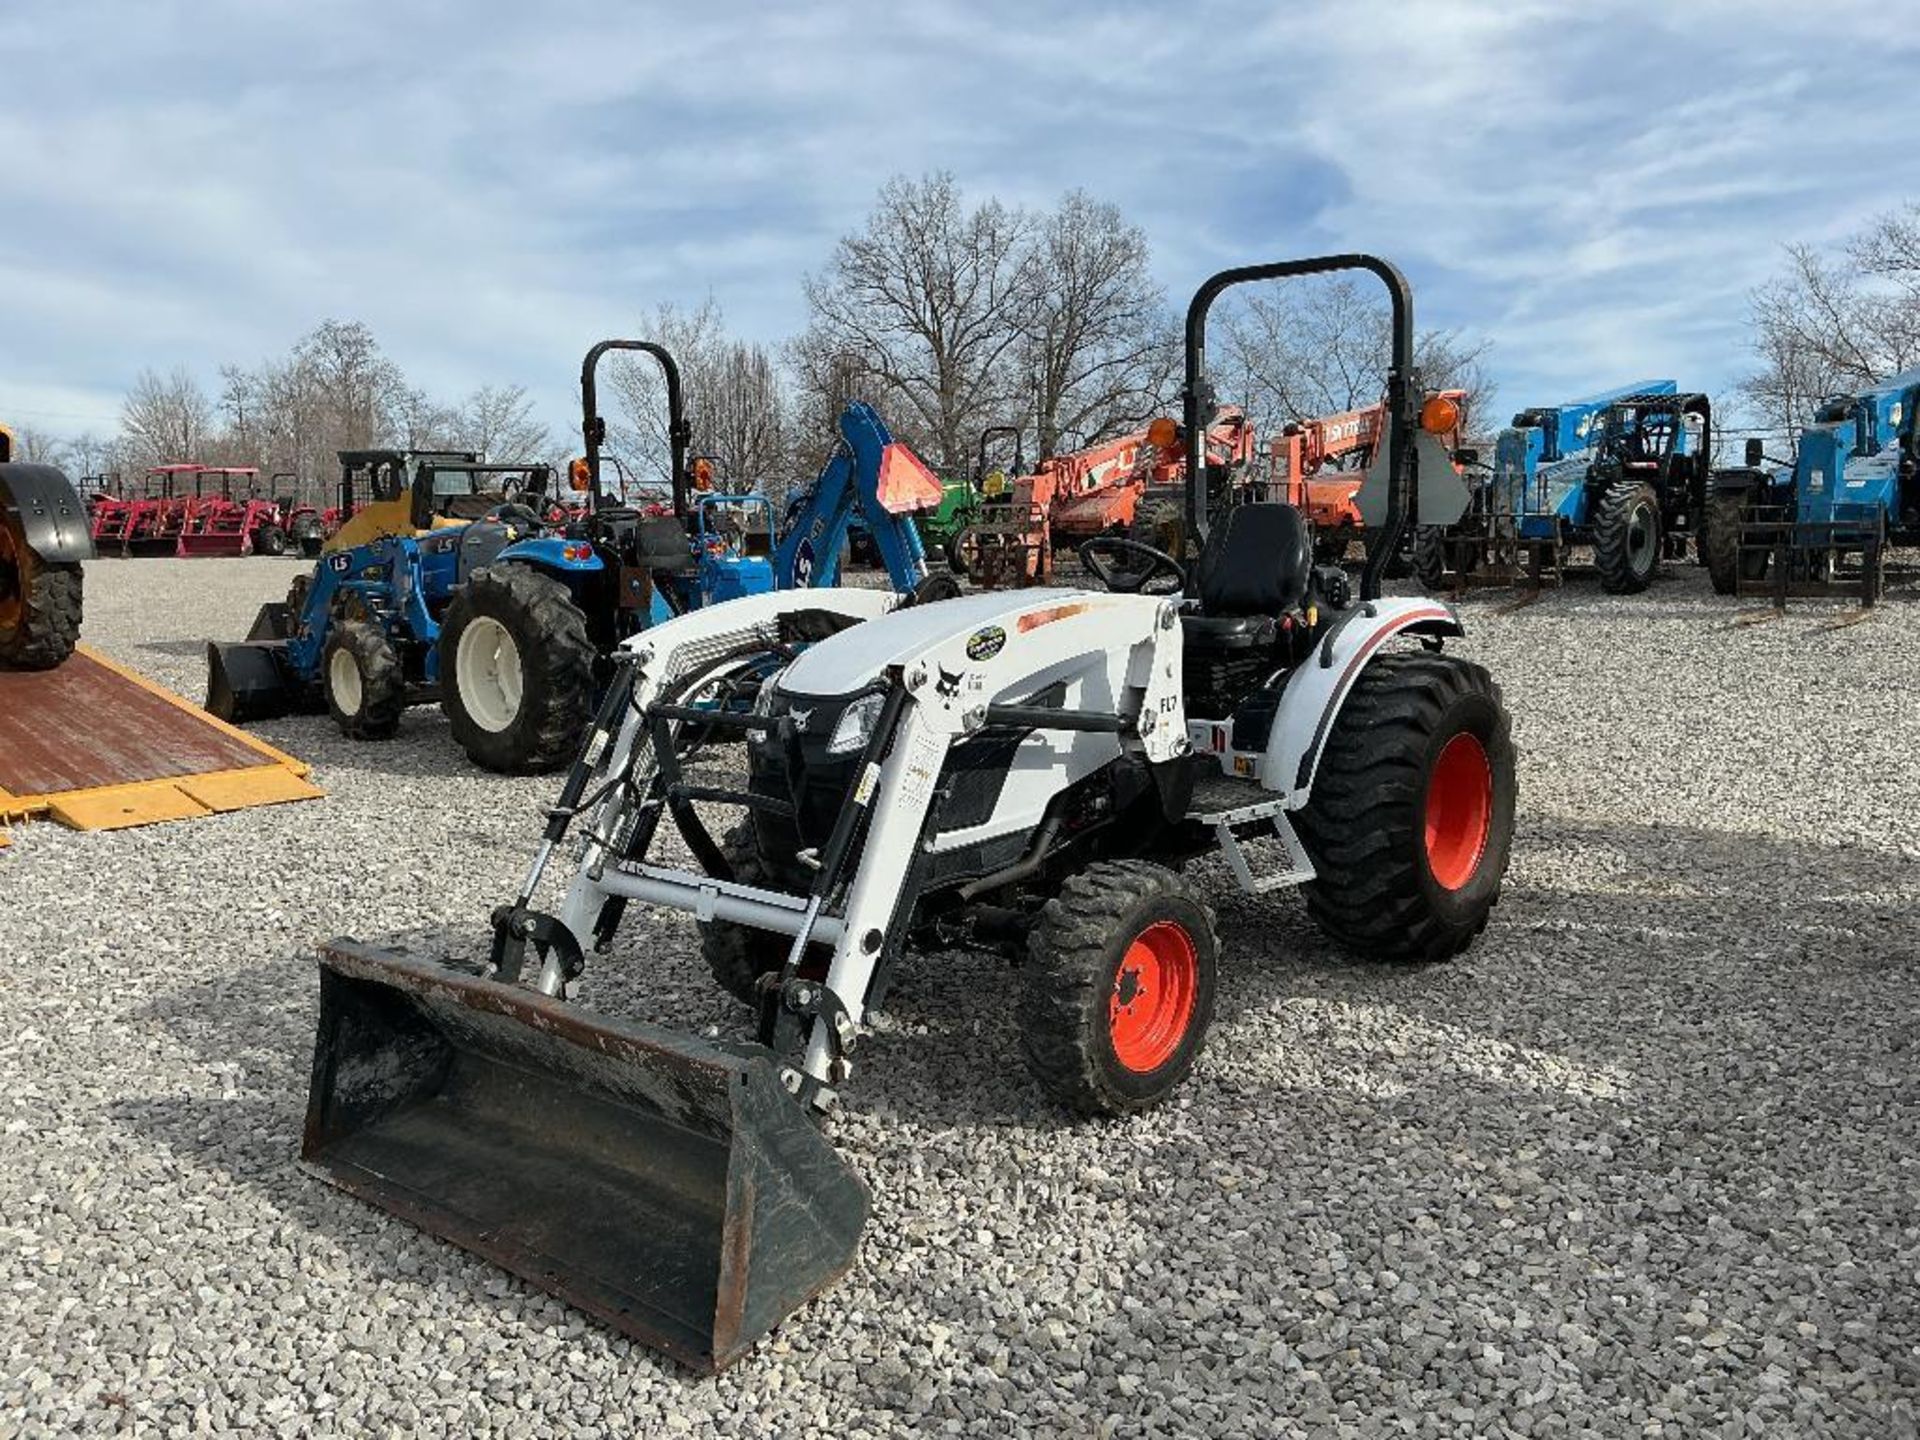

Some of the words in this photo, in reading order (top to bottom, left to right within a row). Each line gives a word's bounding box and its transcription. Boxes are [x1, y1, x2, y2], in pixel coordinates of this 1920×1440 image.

[437, 539, 453, 554] LS
[334, 557, 348, 571] LS
[1160, 695, 1177, 714] FL7
